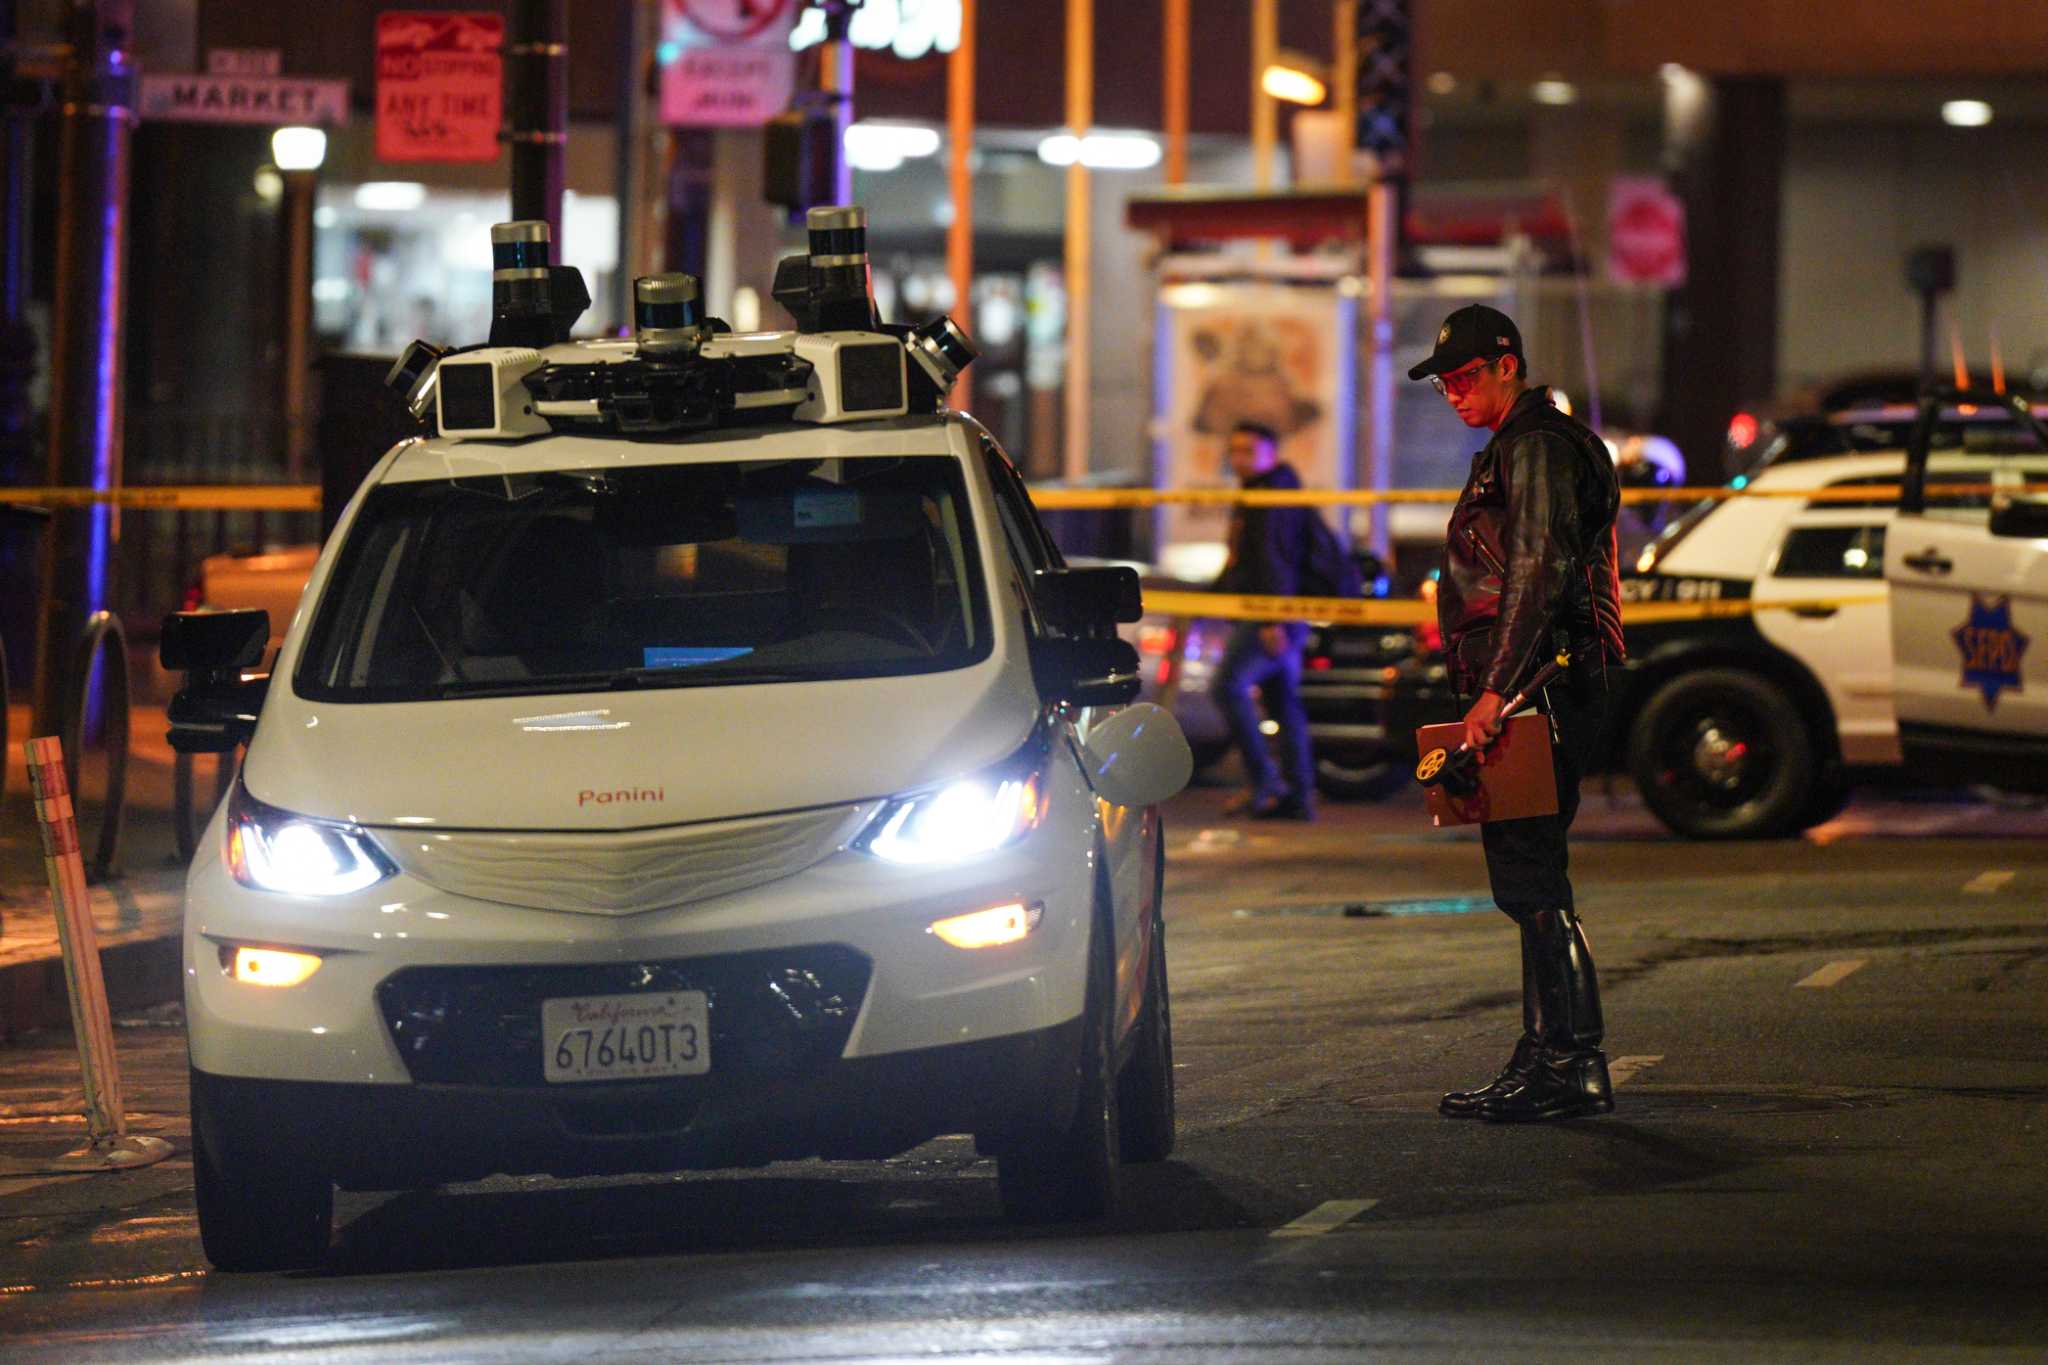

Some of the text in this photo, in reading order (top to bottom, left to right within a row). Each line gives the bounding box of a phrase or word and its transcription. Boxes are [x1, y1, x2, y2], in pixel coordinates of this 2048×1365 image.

[382, 55, 418, 75] NO
[172, 82, 318, 112] MARKET
[386, 93, 489, 118] ANY TIME
[1963, 626, 2019, 672] SFPD
[577, 786, 665, 807] Panini
[555, 1023, 699, 1069] 67640T3
